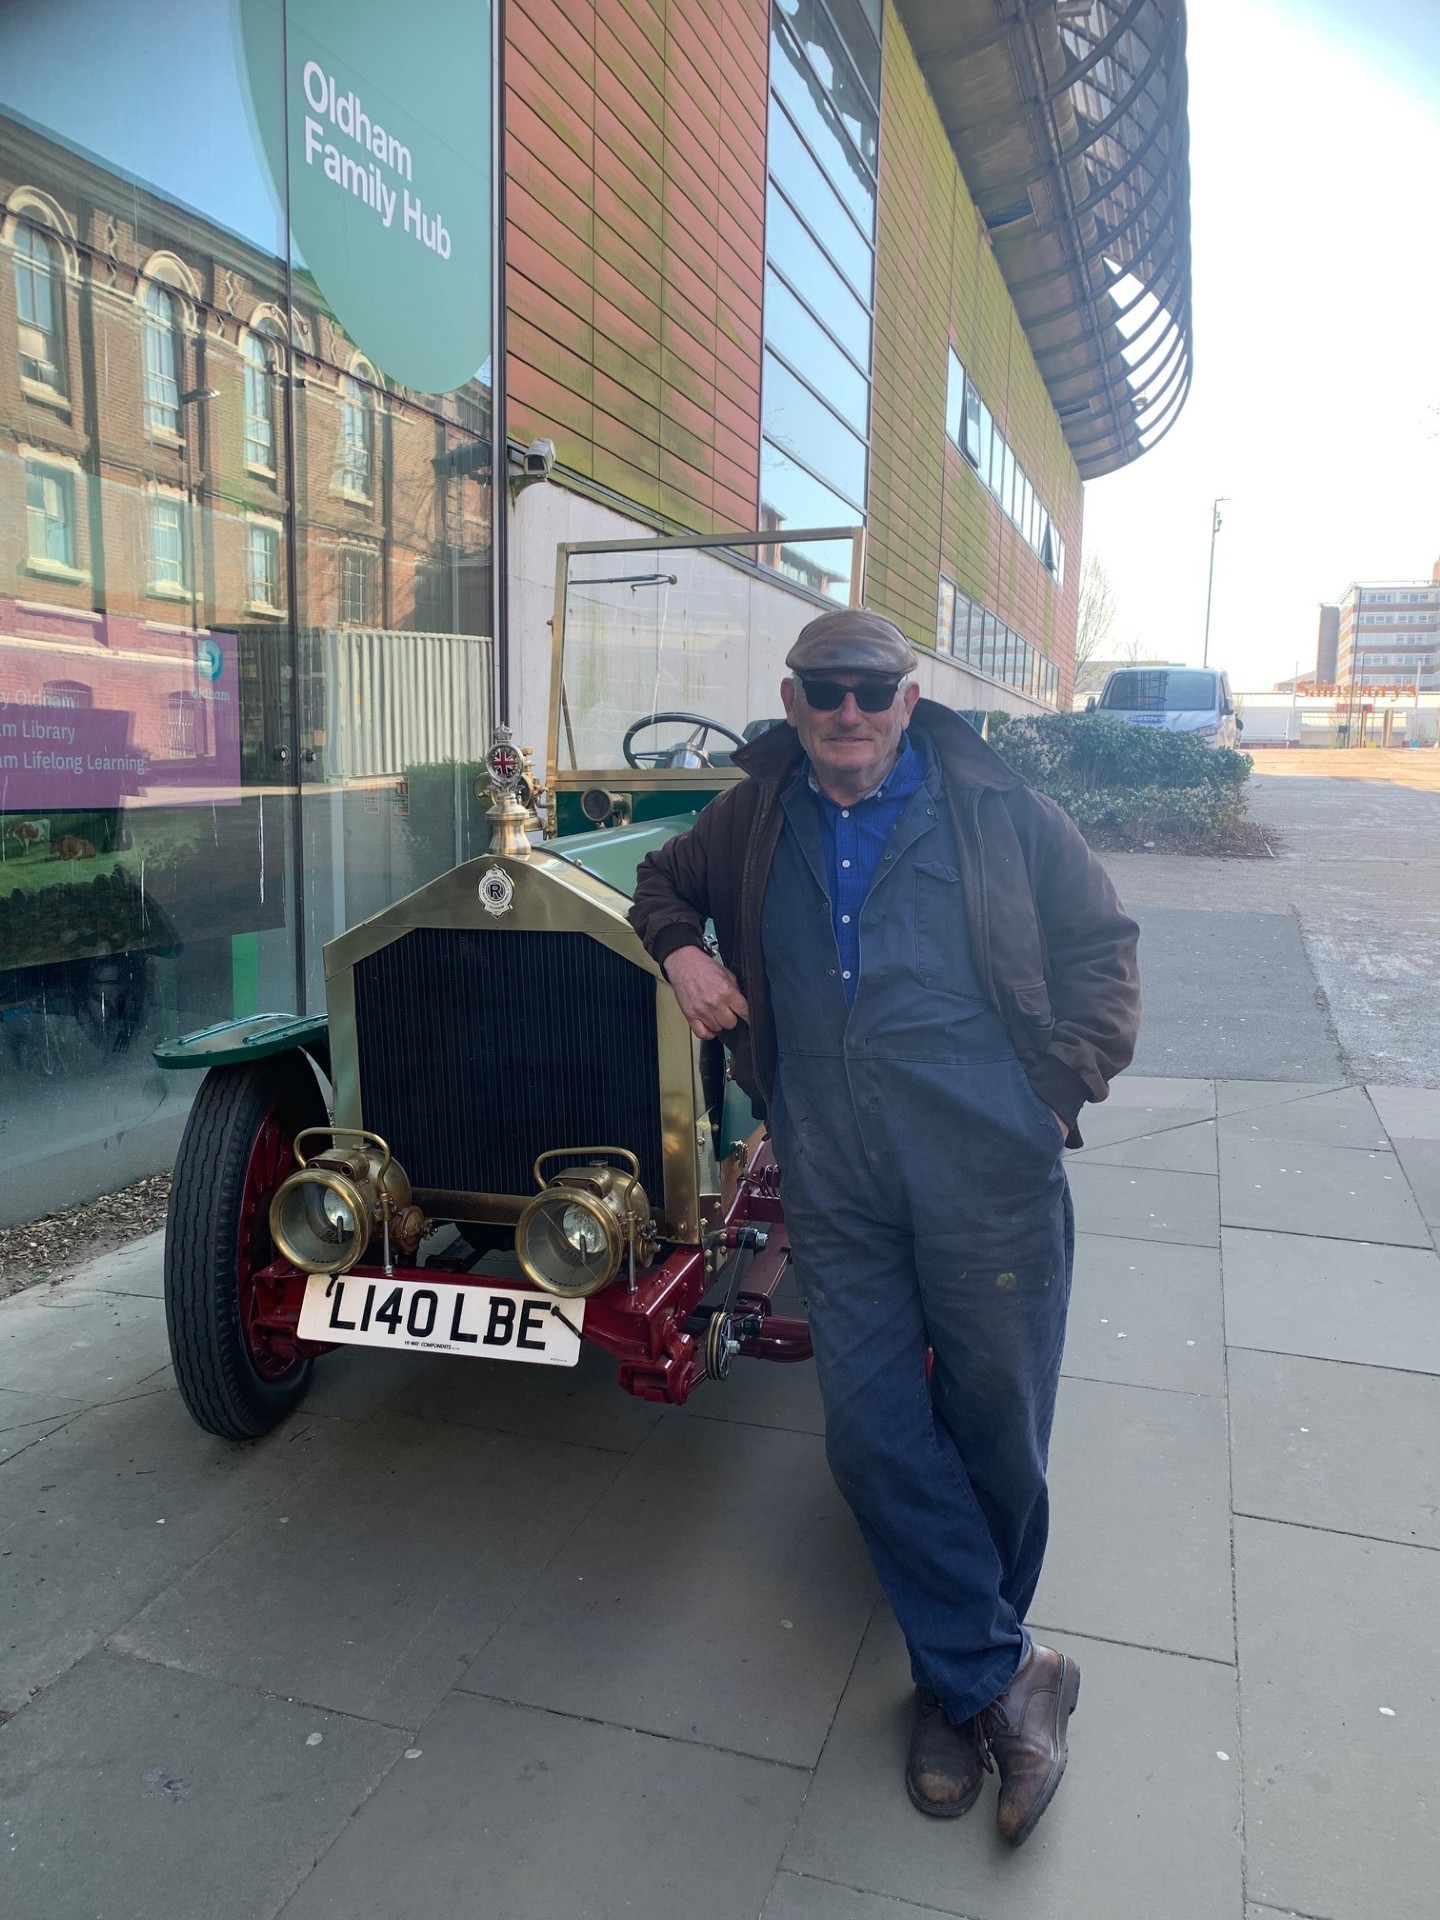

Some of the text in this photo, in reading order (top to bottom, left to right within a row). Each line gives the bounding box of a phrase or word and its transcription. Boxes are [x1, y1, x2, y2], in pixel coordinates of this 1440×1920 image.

[303, 61, 412, 182] Oldham
[305, 115, 451, 260] Family Hub
[15, 689, 74, 708] Oldham
[191, 687, 230, 701] Oldham
[1296, 681, 1417, 702] Sainsbury's
[22, 720, 76, 745] Library
[23, 751, 83, 775] Lifelong
[87, 754, 145, 776] Learning
[490, 884, 502, 898] R
[328, 1281, 552, 1350] L140 LBE
[420, 1341, 452, 1350] COMPONENTS
